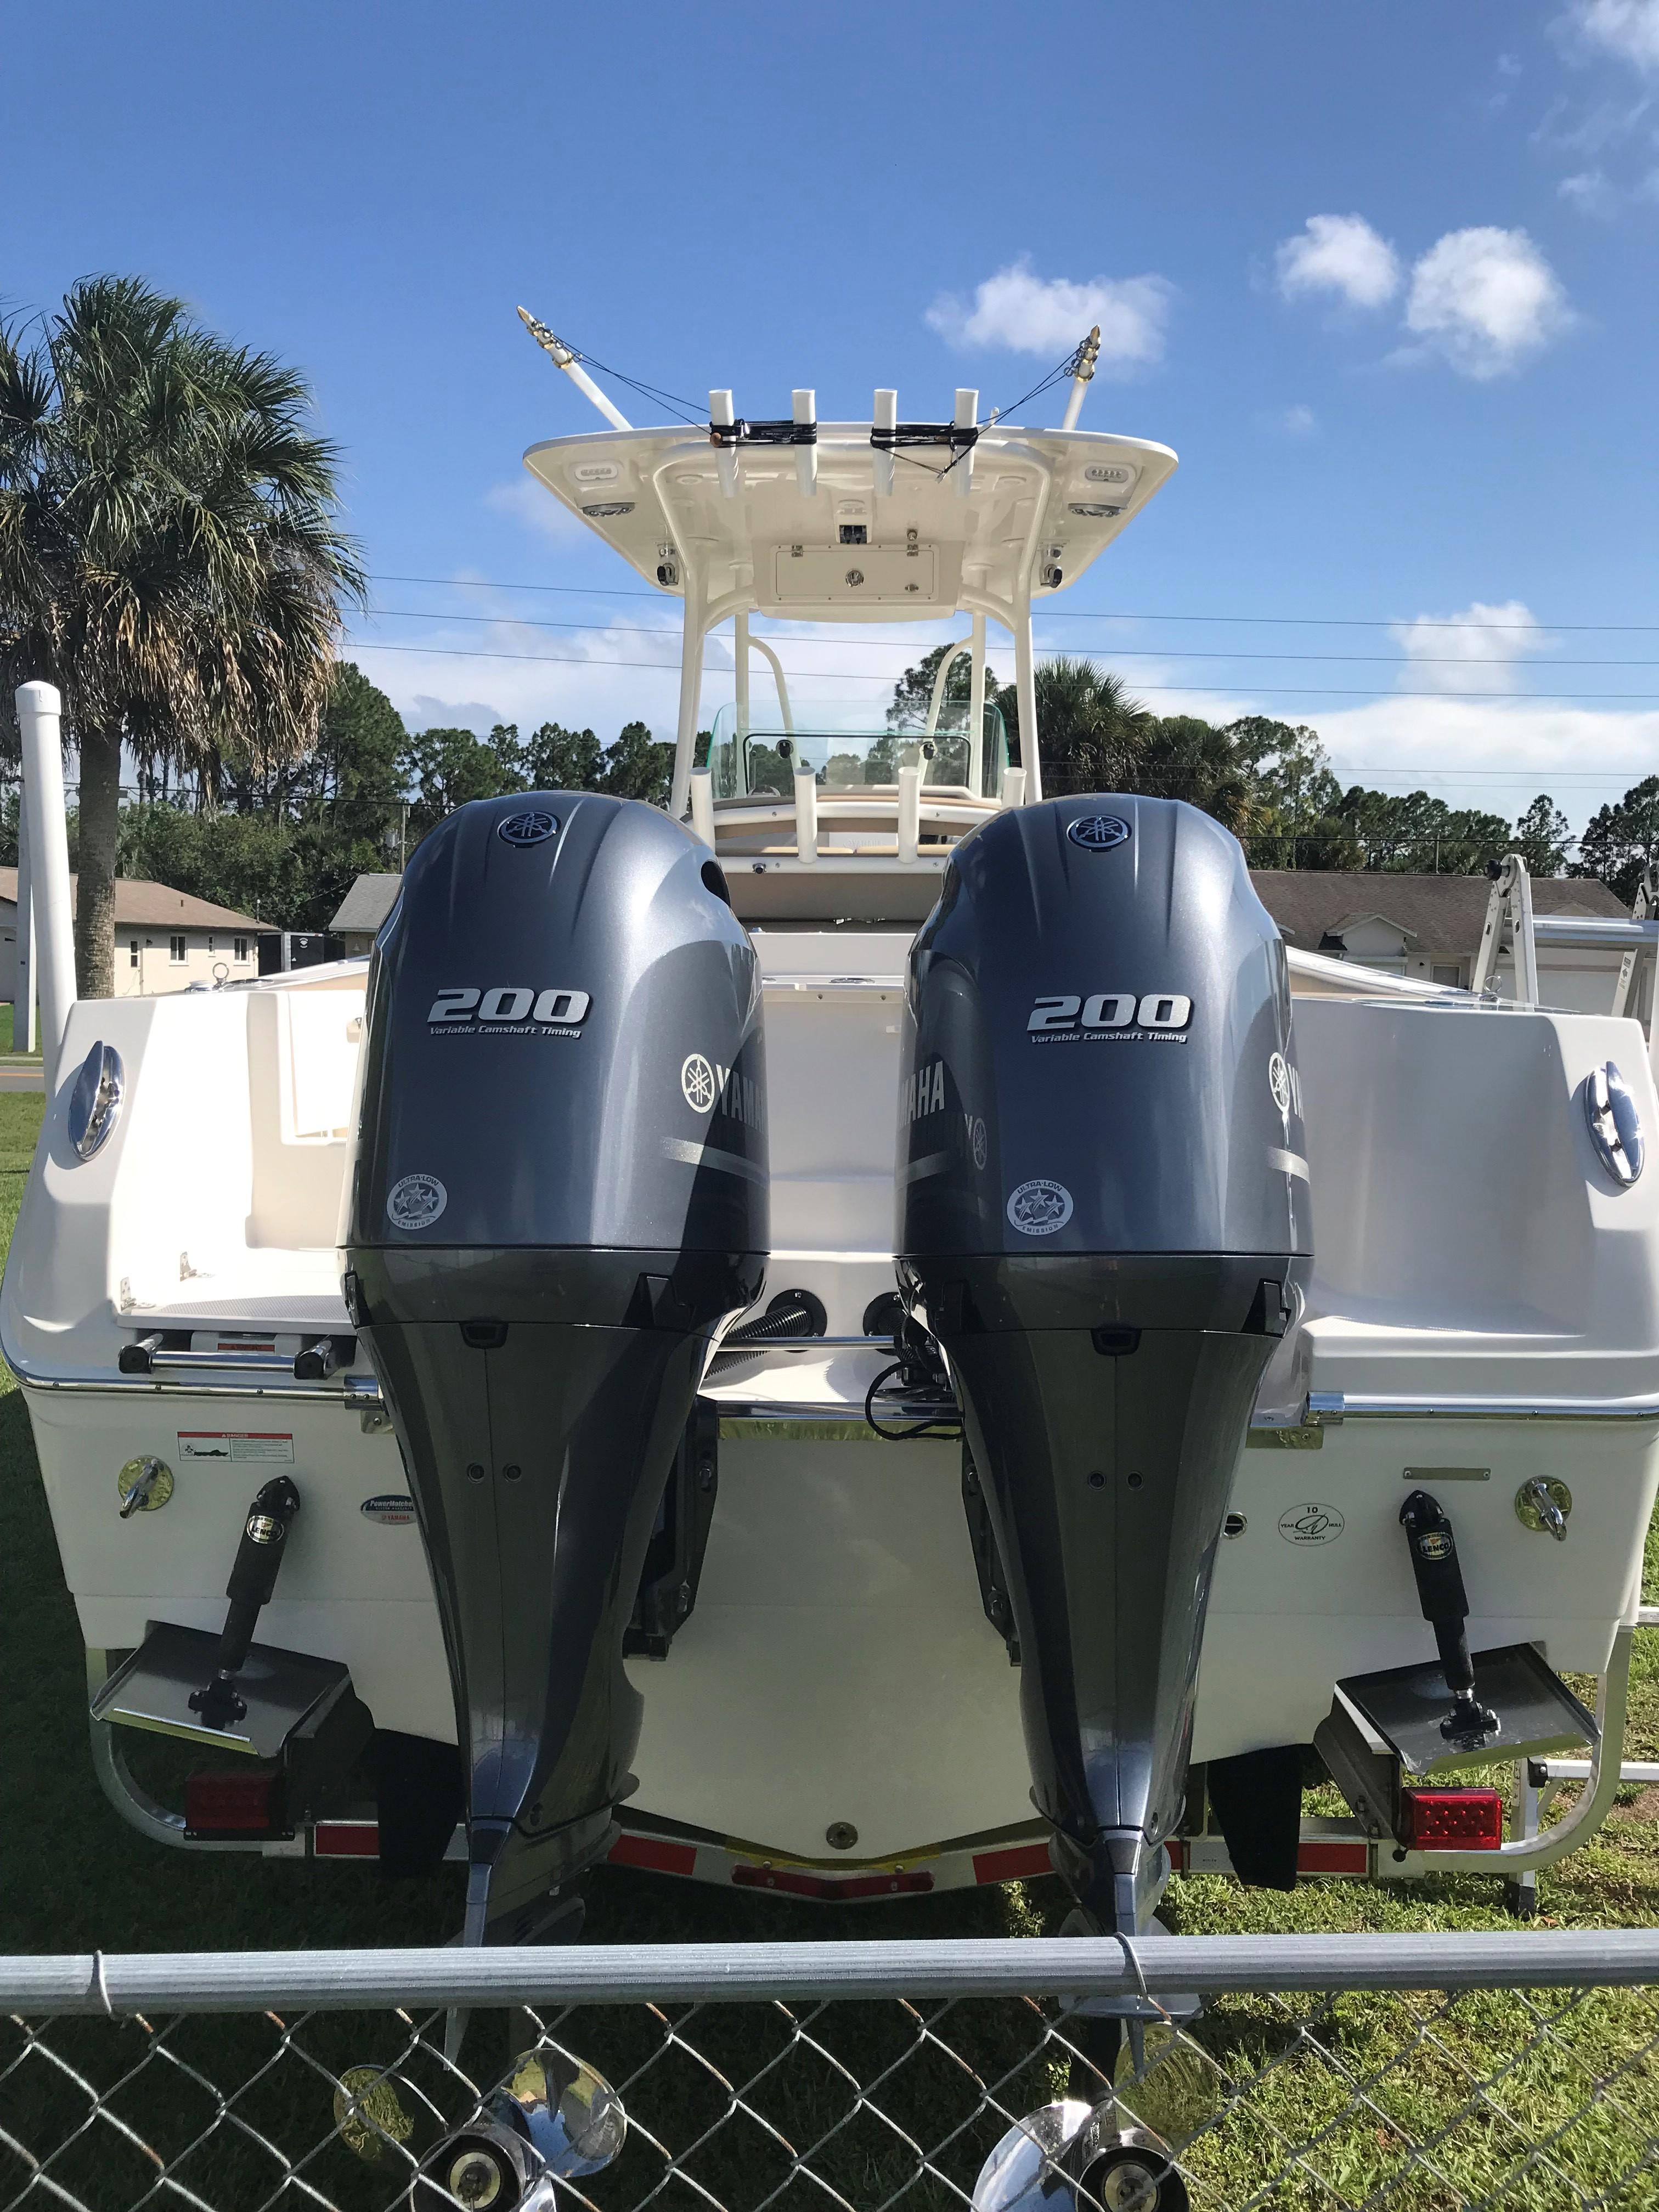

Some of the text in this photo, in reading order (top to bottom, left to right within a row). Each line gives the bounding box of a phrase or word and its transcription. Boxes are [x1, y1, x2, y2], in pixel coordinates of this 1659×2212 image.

[427, 988, 590, 1023] 200
[1027, 994, 1191, 1031] 200
[431, 1025, 582, 1038] Variable Camshaft Timing
[1031, 1032, 1187, 1043] Variable Camshaft Timing
[899, 1060, 945, 1128] MAHA
[1022, 1223, 1058, 1233] EMISSION
